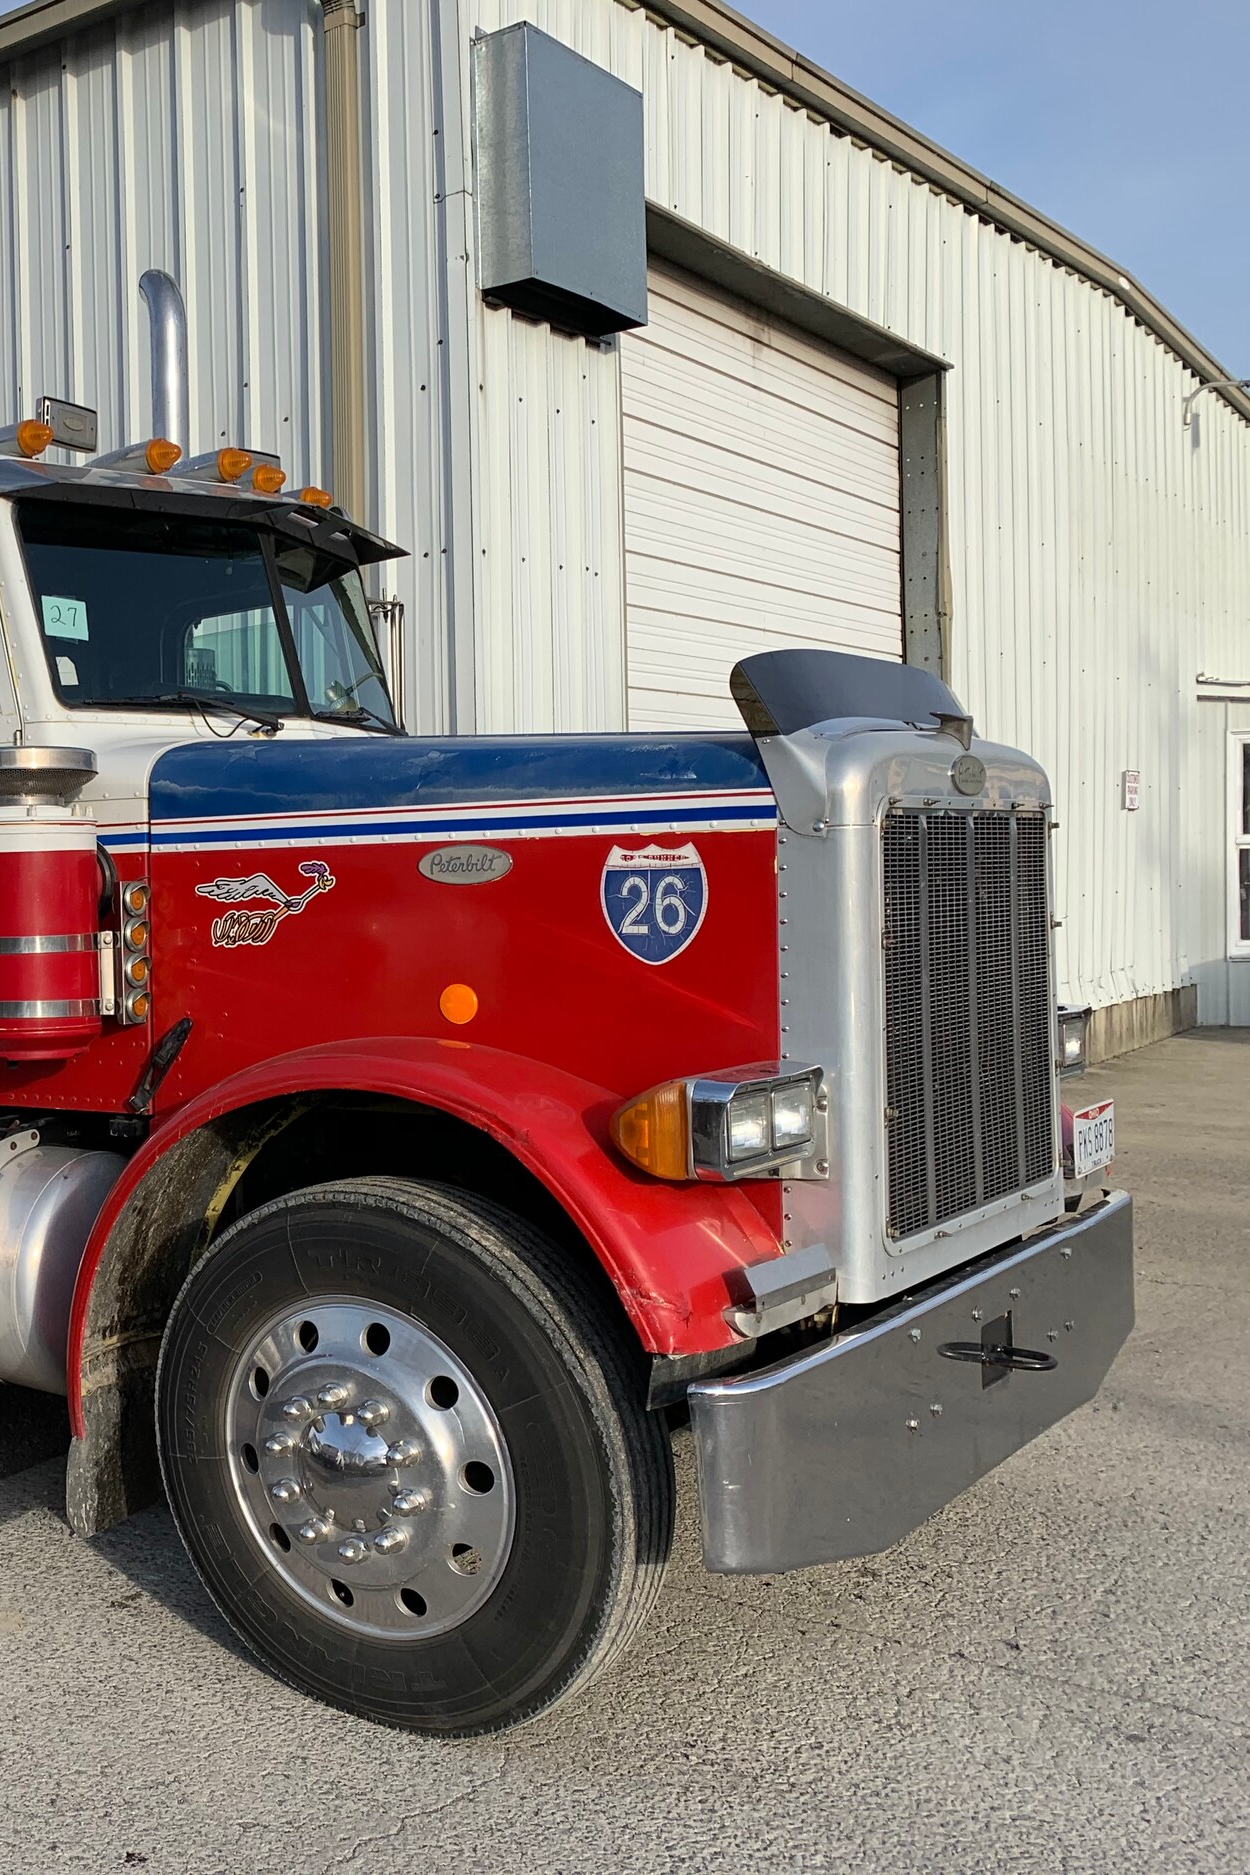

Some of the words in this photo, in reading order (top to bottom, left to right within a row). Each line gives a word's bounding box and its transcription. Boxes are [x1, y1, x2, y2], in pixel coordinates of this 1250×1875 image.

[50, 605, 77, 627] 27
[430, 853, 502, 875] Peterbilt
[620, 876, 687, 935] 26
[1078, 1126, 1093, 1162] PKS
[1093, 1117, 1114, 1154] 8878
